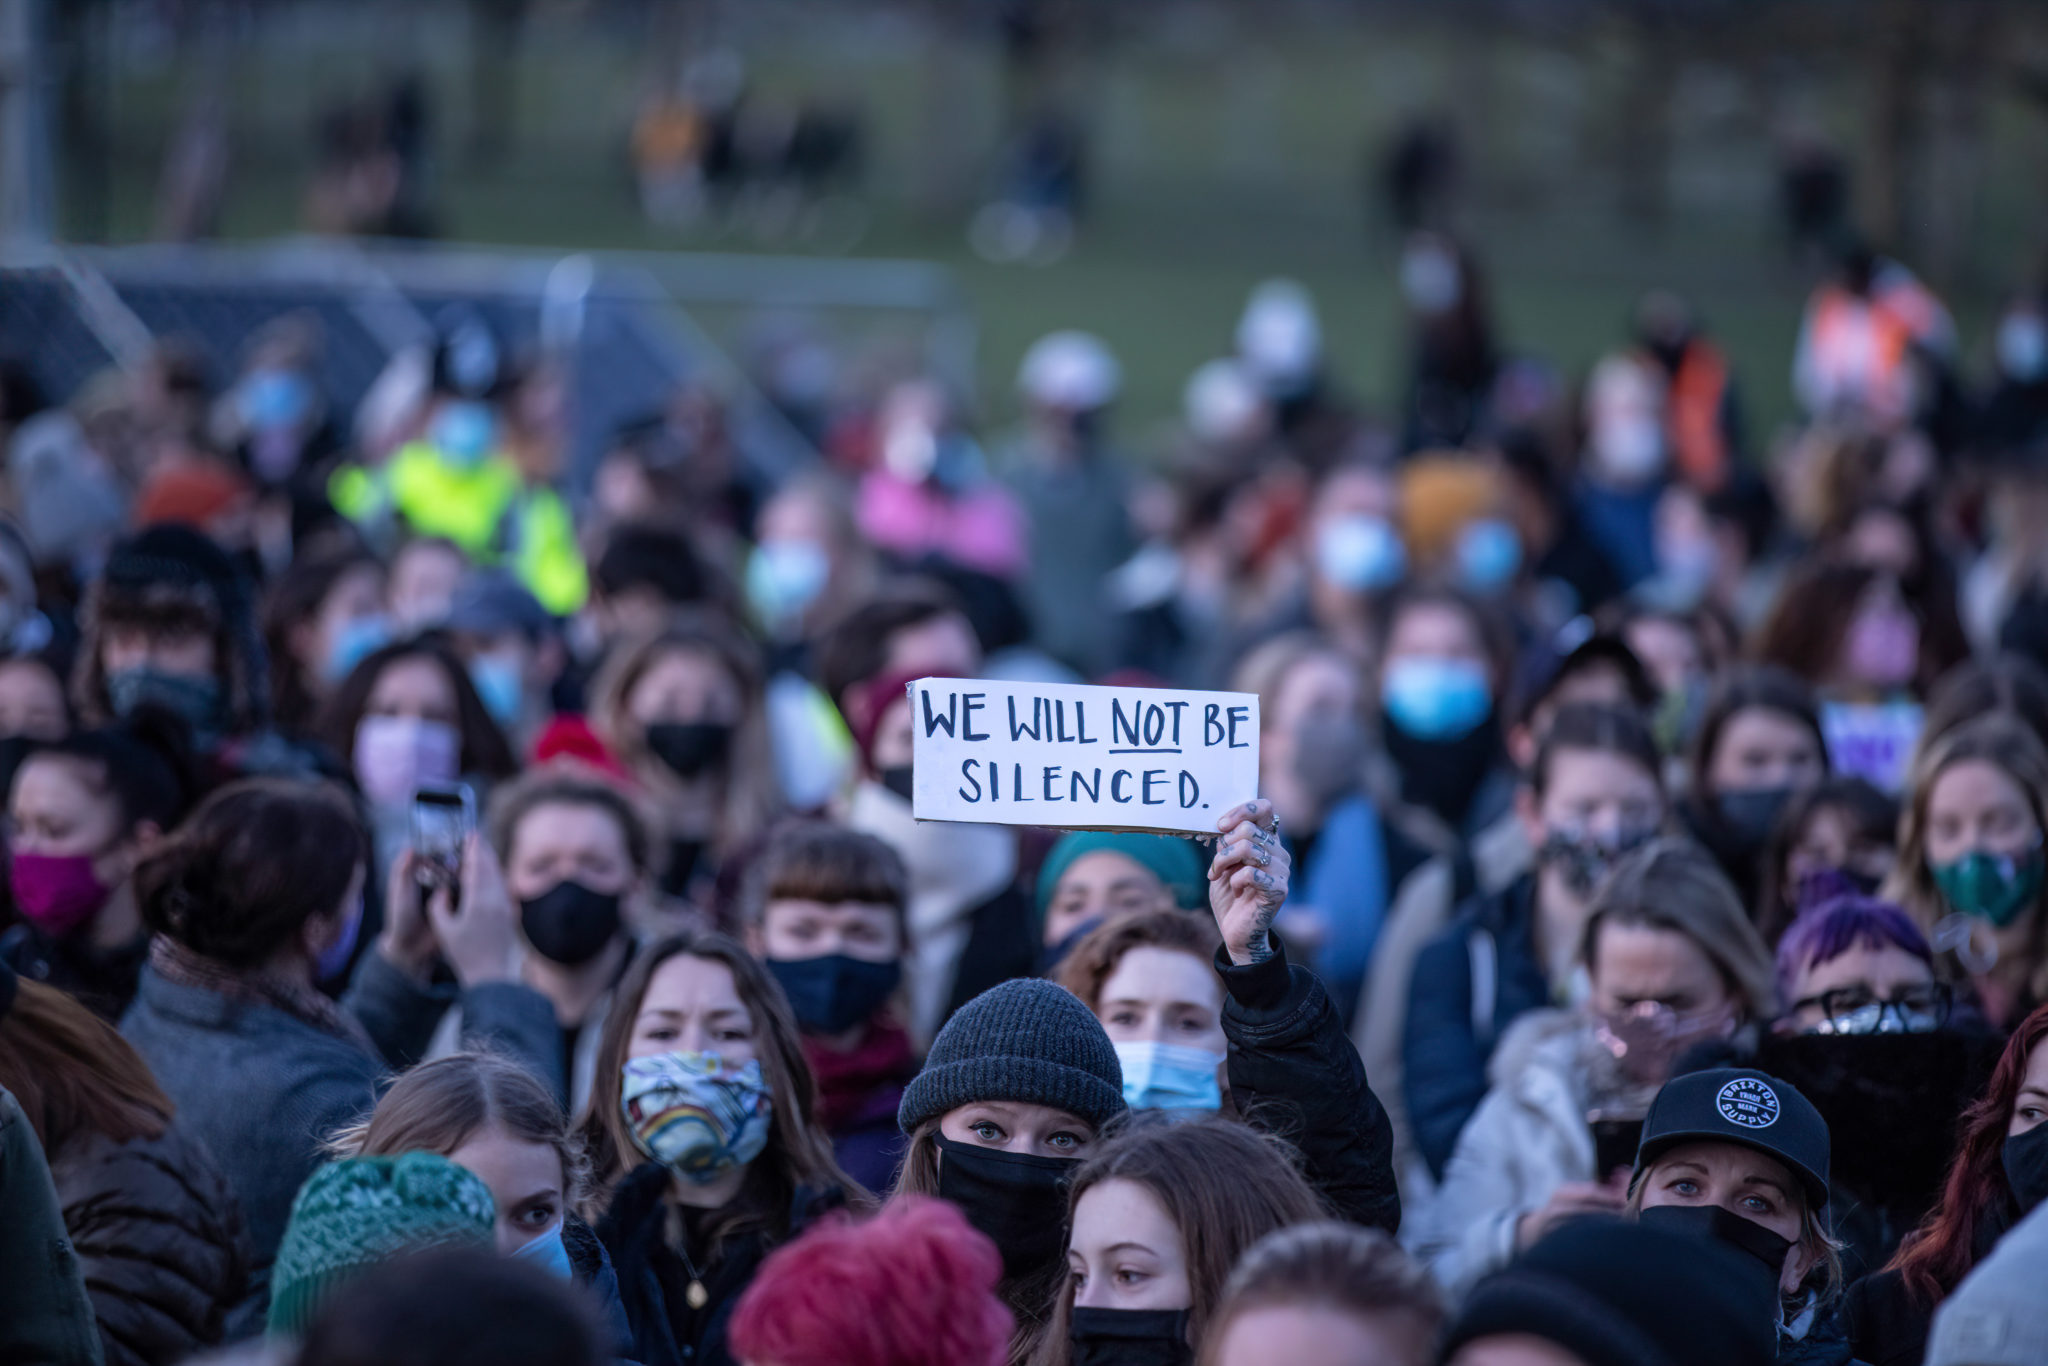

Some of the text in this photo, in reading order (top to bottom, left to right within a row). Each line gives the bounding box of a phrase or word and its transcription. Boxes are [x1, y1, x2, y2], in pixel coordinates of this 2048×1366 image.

[921, 690, 1249, 748] WE WILL NOT BE
[959, 758, 1209, 809] SILENCED.
[1723, 1081, 1777, 1107] BRIXTON
[1722, 1103, 1771, 1125] SUPPLY
